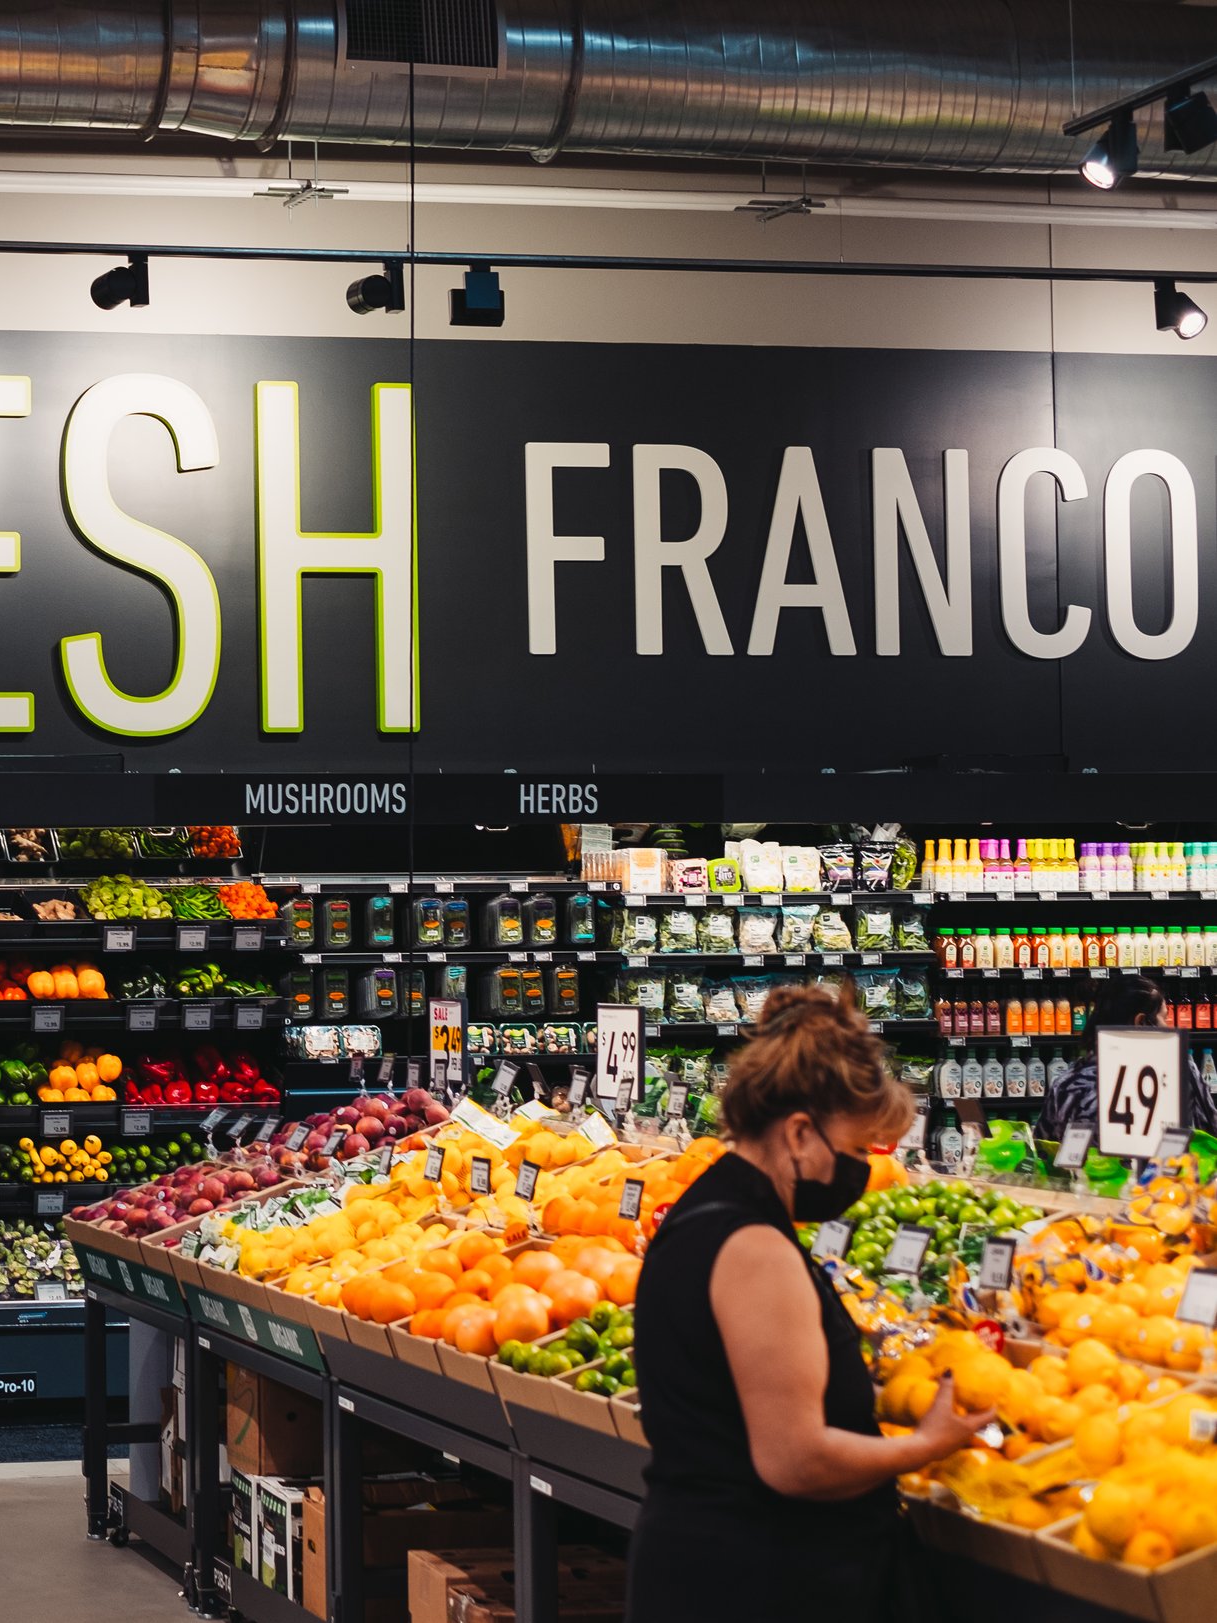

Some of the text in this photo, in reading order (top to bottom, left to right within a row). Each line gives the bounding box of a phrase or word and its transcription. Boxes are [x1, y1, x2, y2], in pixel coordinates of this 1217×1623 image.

[525, 442, 1199, 660] FRANCO
[245, 782, 407, 815] MUSHROOMS
[519, 783, 599, 815] HERBS
[434, 1008, 448, 1021] SALE
[506, 1230, 527, 1244] SALE
[86, 1253, 112, 1280] ORGANIC
[141, 1272, 170, 1301] ORGANIC
[198, 1294, 230, 1326] ORGANIC
[268, 1320, 304, 1356] ORGANIC
